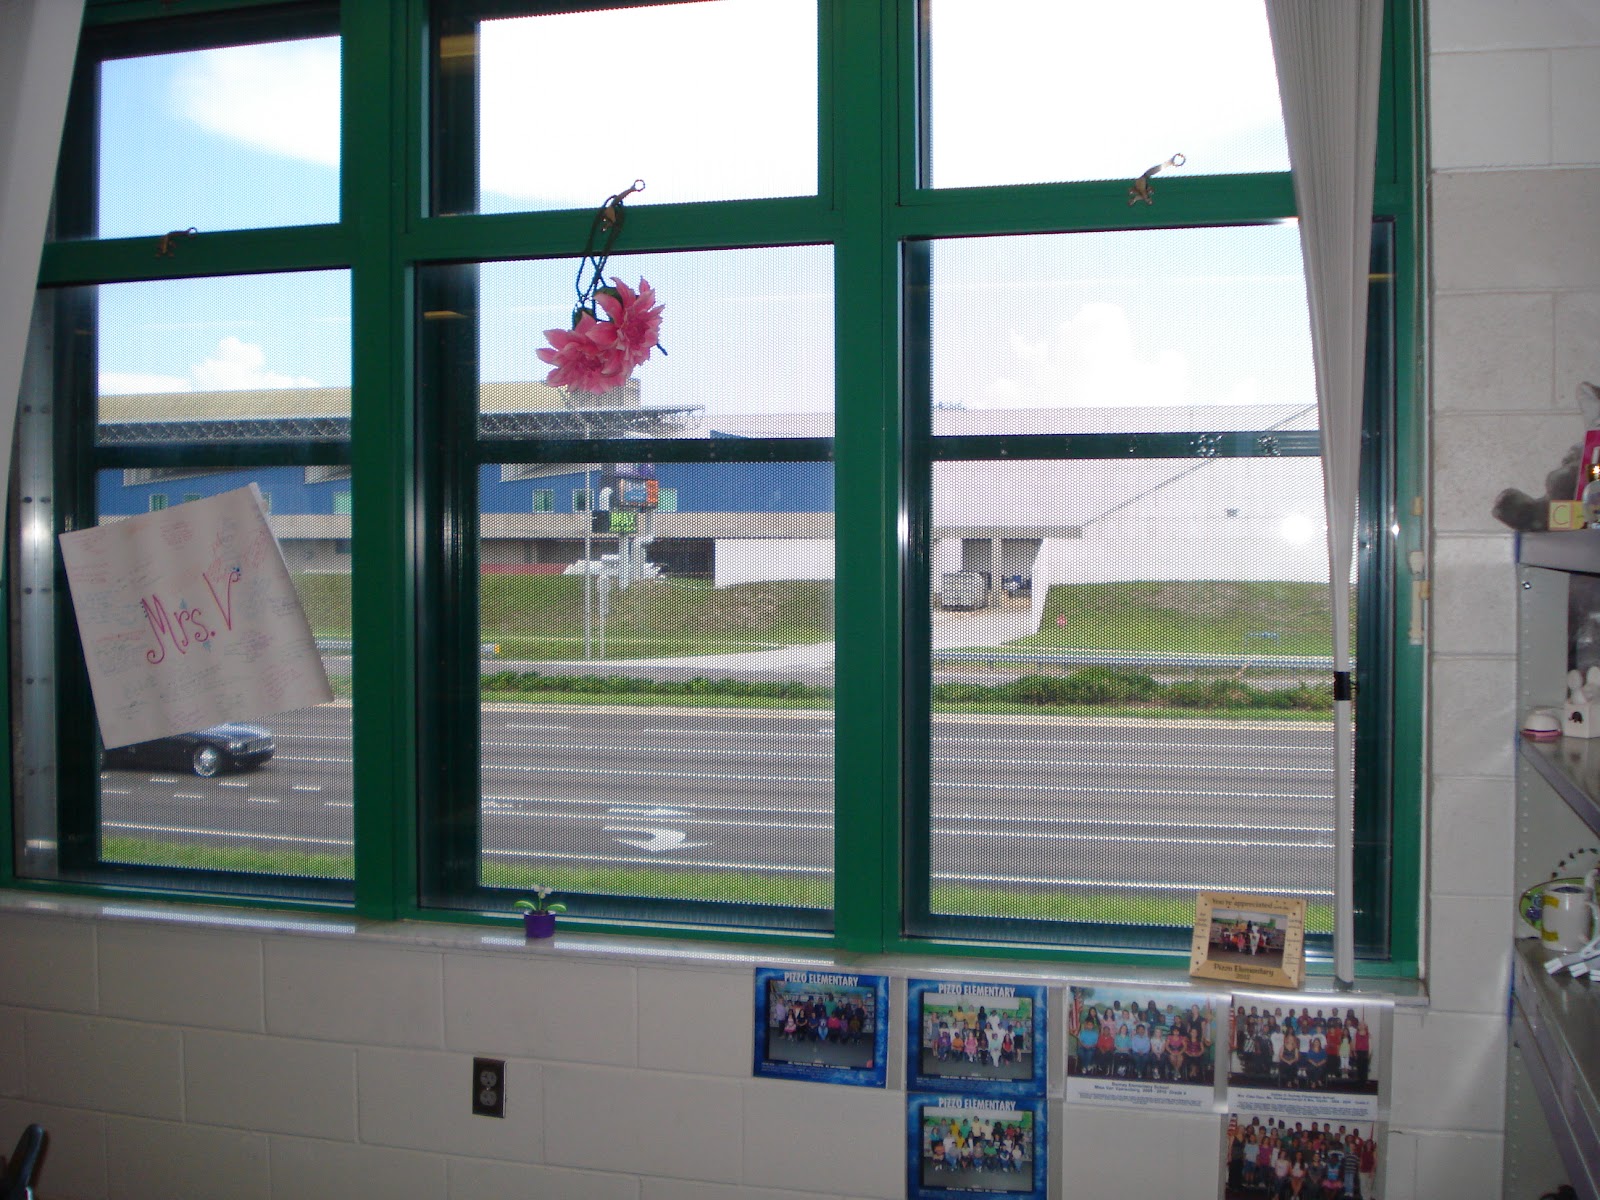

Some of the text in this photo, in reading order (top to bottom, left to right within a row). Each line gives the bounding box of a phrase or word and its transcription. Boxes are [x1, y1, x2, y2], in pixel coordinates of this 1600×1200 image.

[141, 594, 216, 664] Mrs.
[202, 570, 241, 631] V
[784, 971, 859, 987] PIZZO ELEMENTARY
[938, 983, 1016, 998] PIZZO ELEMENTARY
[938, 1097, 1017, 1111] PIZZO ELEMENTARY
